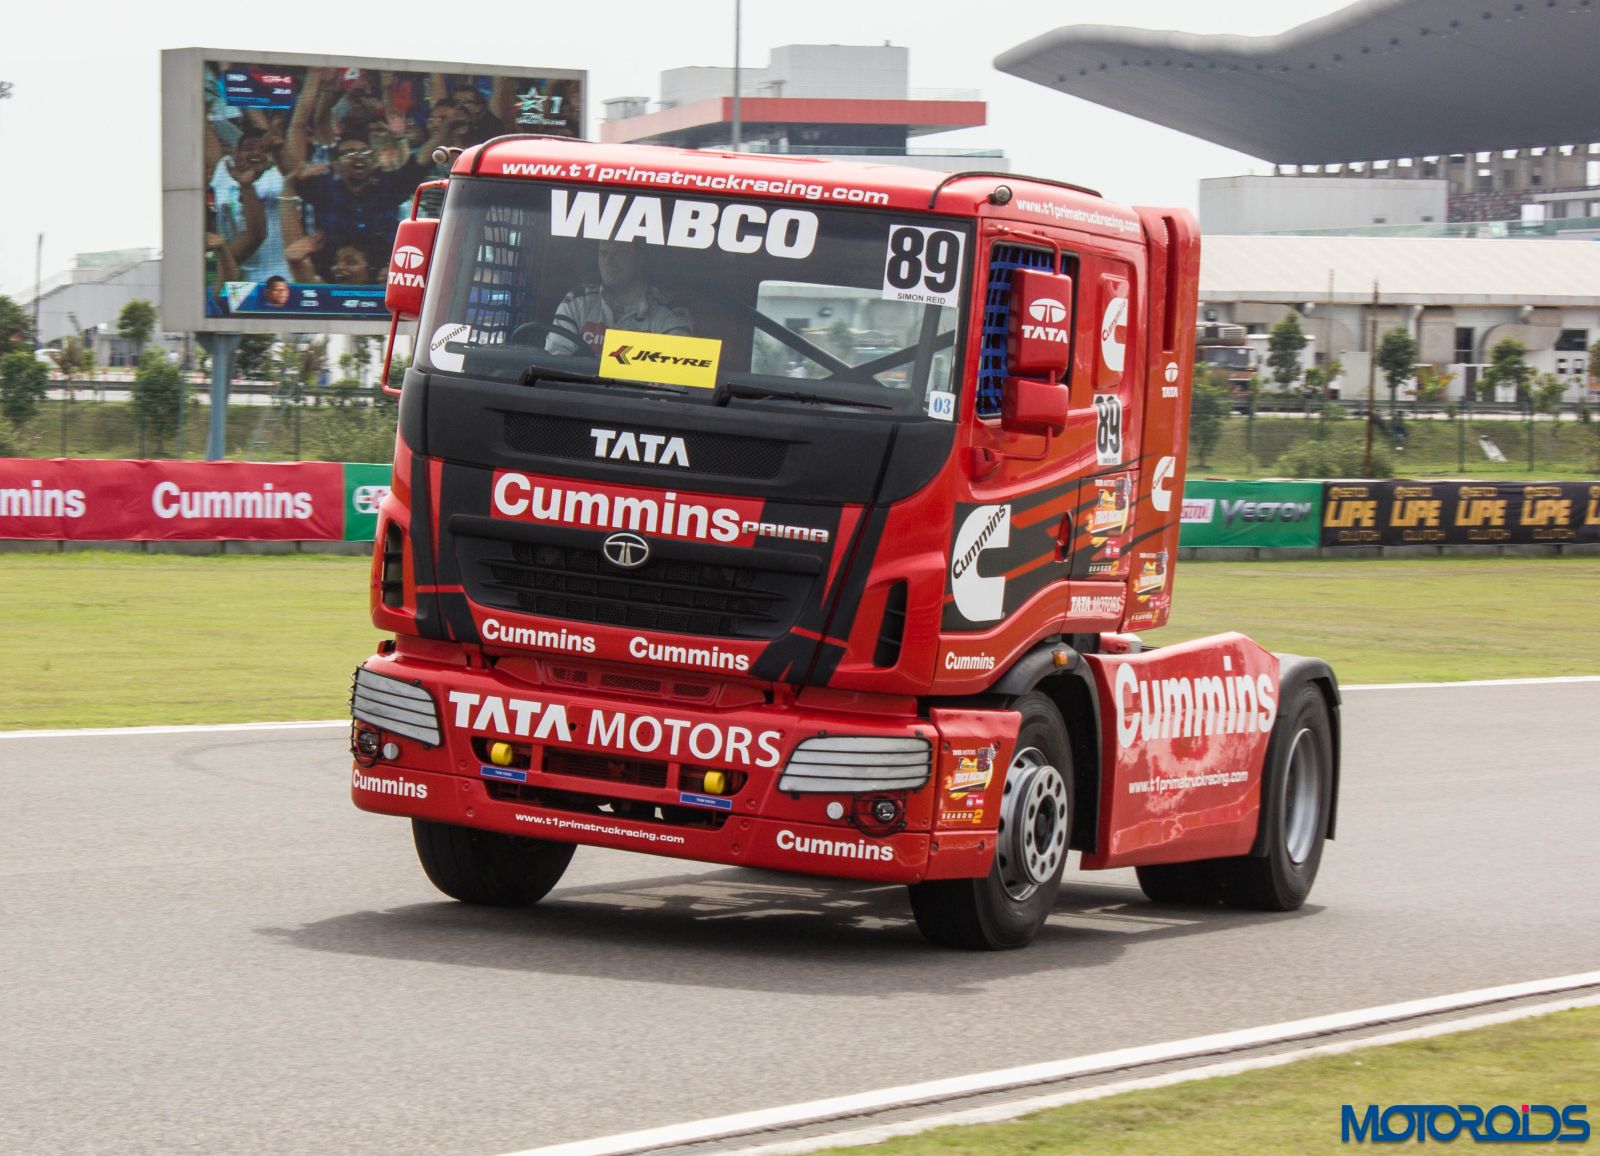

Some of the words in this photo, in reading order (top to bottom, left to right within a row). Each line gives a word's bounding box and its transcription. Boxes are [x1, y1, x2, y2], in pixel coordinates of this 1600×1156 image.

[502, 163, 889, 205] www.t1primatruckracing.com
[551, 189, 819, 259] WABCO
[887, 227, 961, 294] 89
[388, 272, 425, 288] TATA
[897, 292, 924, 302] SIMON
[926, 295, 946, 304] REID
[430, 324, 468, 352] Cummins
[1021, 325, 1068, 344] TATA
[934, 396, 950, 414] 03
[1162, 386, 1178, 398] TATA
[1095, 396, 1120, 454] 89
[590, 428, 690, 467] TATA
[0, 480, 86, 518] mins
[152, 481, 313, 519] Cummins
[494, 472, 740, 542] Cummins
[741, 521, 829, 543] PRIMA
[952, 504, 1007, 580] Cummins
[482, 619, 596, 653] Cummins
[629, 637, 749, 671] Cummins
[945, 652, 995, 670] Cummins
[1115, 656, 1277, 749] Cummins
[449, 691, 572, 742] TATA
[587, 709, 781, 769] MOTORS
[352, 769, 428, 799] Cummins
[515, 813, 685, 844] www.t1primatruckracing.com
[972, 809, 984, 824] 2
[776, 829, 894, 862] Cummins
